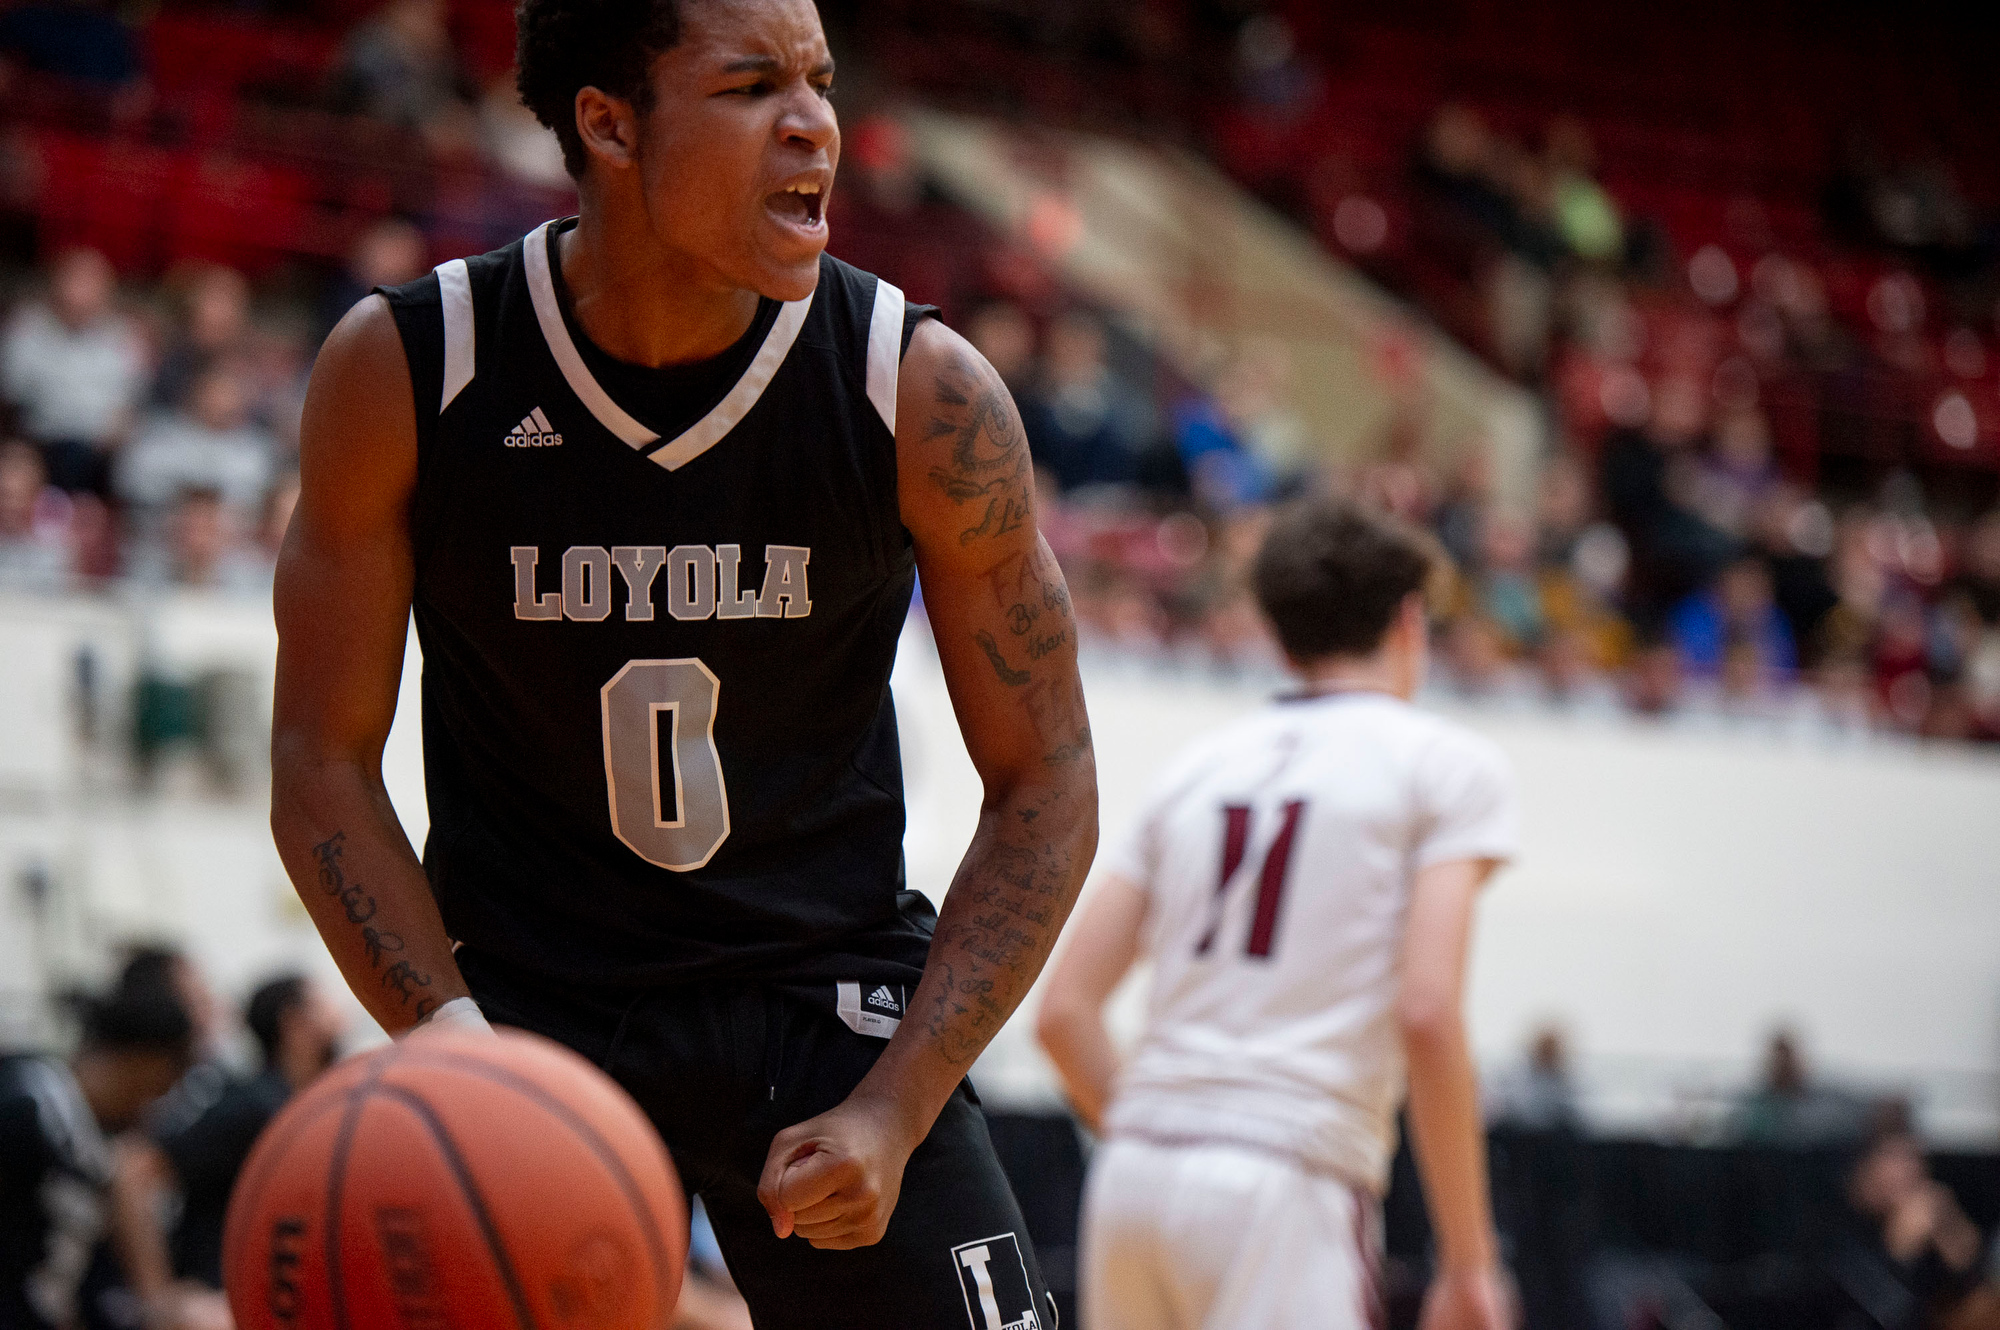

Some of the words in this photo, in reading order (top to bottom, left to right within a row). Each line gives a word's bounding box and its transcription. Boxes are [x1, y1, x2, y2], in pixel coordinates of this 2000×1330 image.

[503, 432, 563, 447] adidas
[510, 544, 812, 621] LOYOLA
[600, 657, 731, 873] 0
[1194, 799, 1307, 958] 11
[867, 996, 900, 1012] adidas
